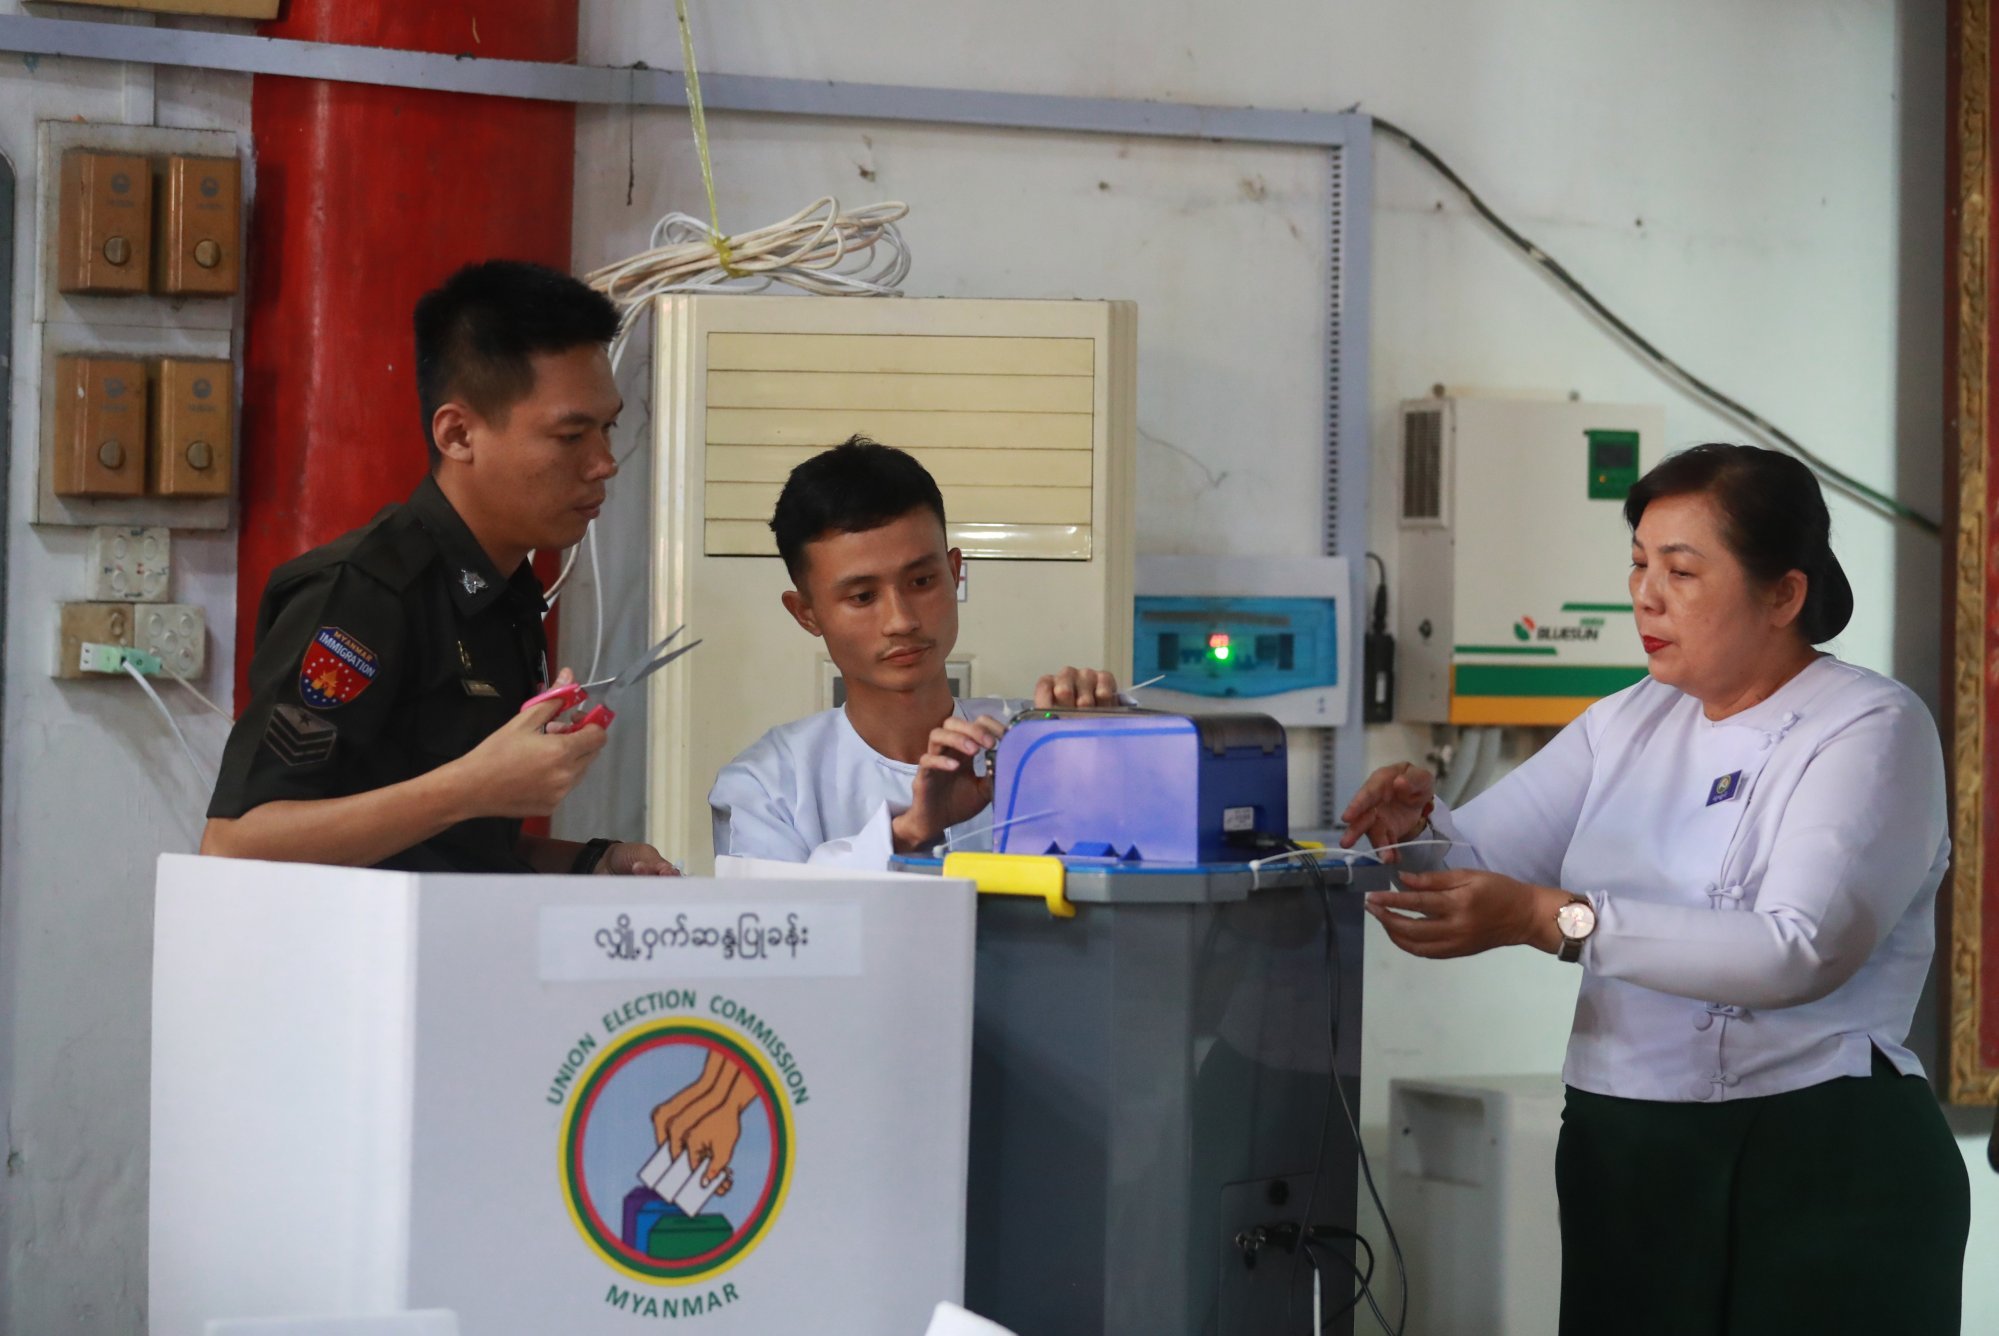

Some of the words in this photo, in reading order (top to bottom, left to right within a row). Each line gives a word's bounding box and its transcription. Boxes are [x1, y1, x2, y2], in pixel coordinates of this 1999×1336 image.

[319, 632, 376, 677] IMMIGRATION
[333, 630, 373, 662] MYANMAR
[547, 1033, 597, 1106] UNION
[602, 990, 697, 1033] ELECTION
[709, 995, 810, 1106] COMMISSION
[605, 1282, 740, 1319] MYANMAR
